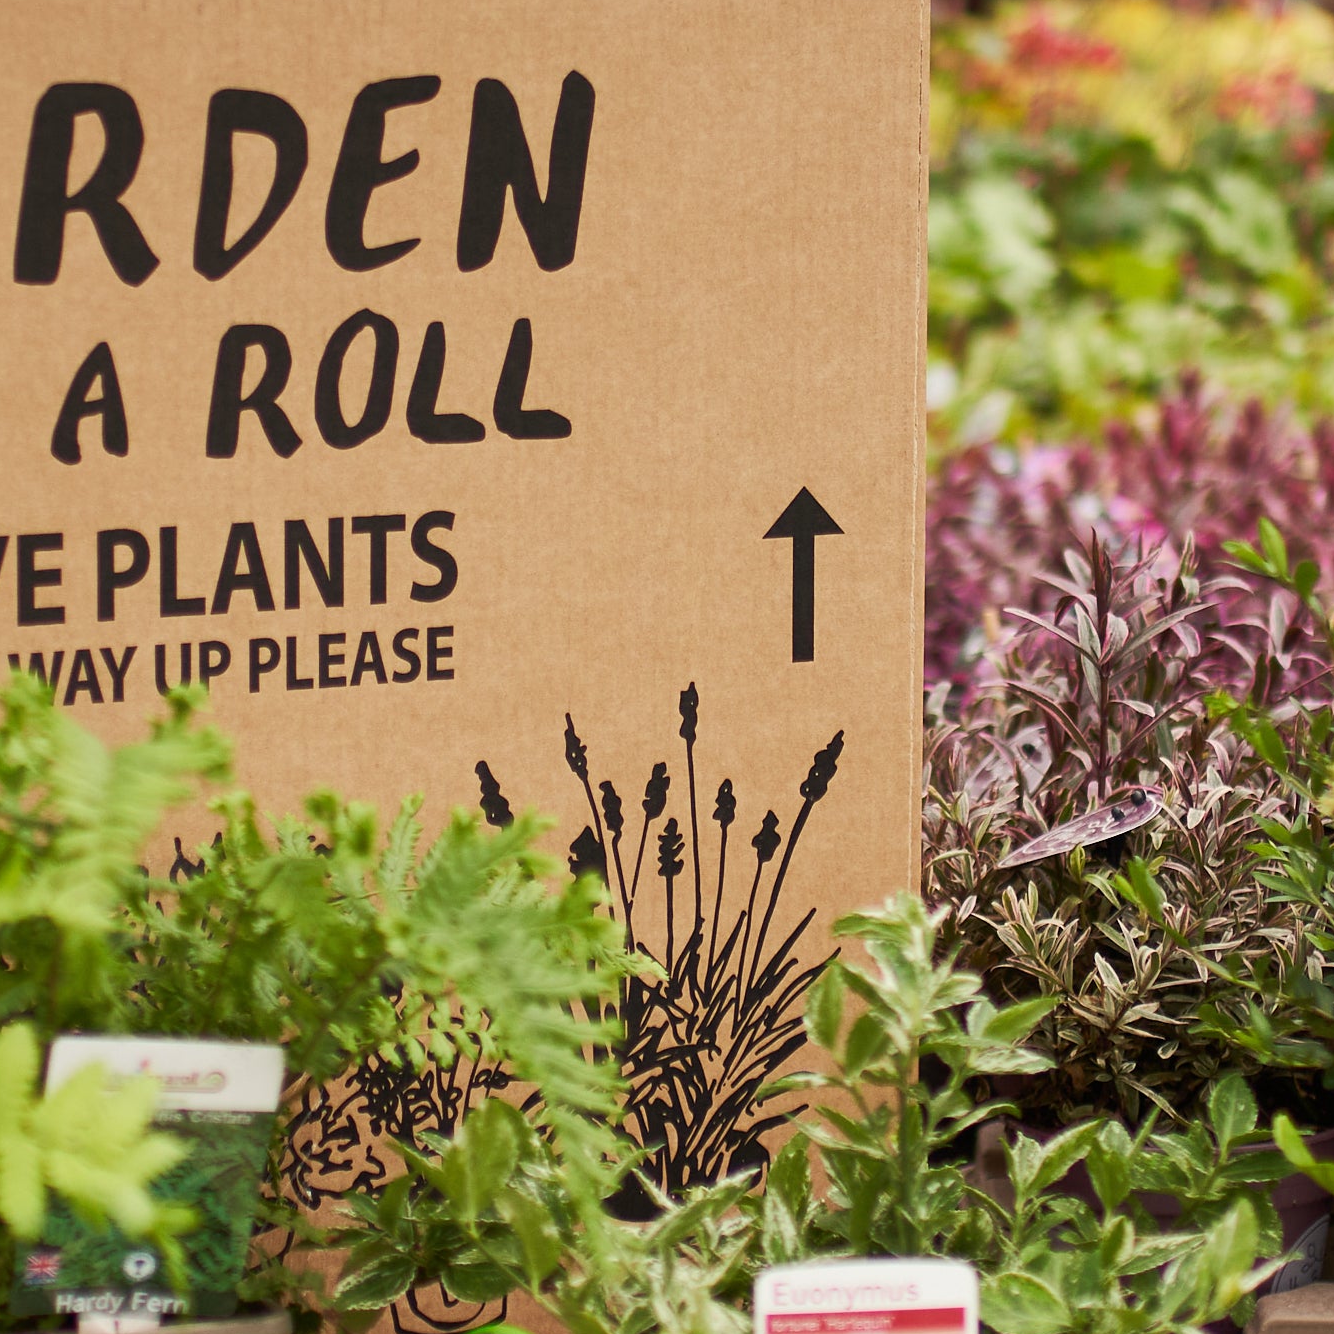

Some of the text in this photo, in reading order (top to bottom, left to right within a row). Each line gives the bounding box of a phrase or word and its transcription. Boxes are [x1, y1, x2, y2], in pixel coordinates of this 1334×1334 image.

[50, 341, 129, 465] A
[205, 307, 572, 459] ROLL
[97, 510, 460, 622] PLANTS
[154, 640, 232, 697] UP
[248, 624, 455, 694] PLEASE
[55, 1291, 188, 1315] Hardy Fern
[771, 1280, 921, 1311] Euonymus
